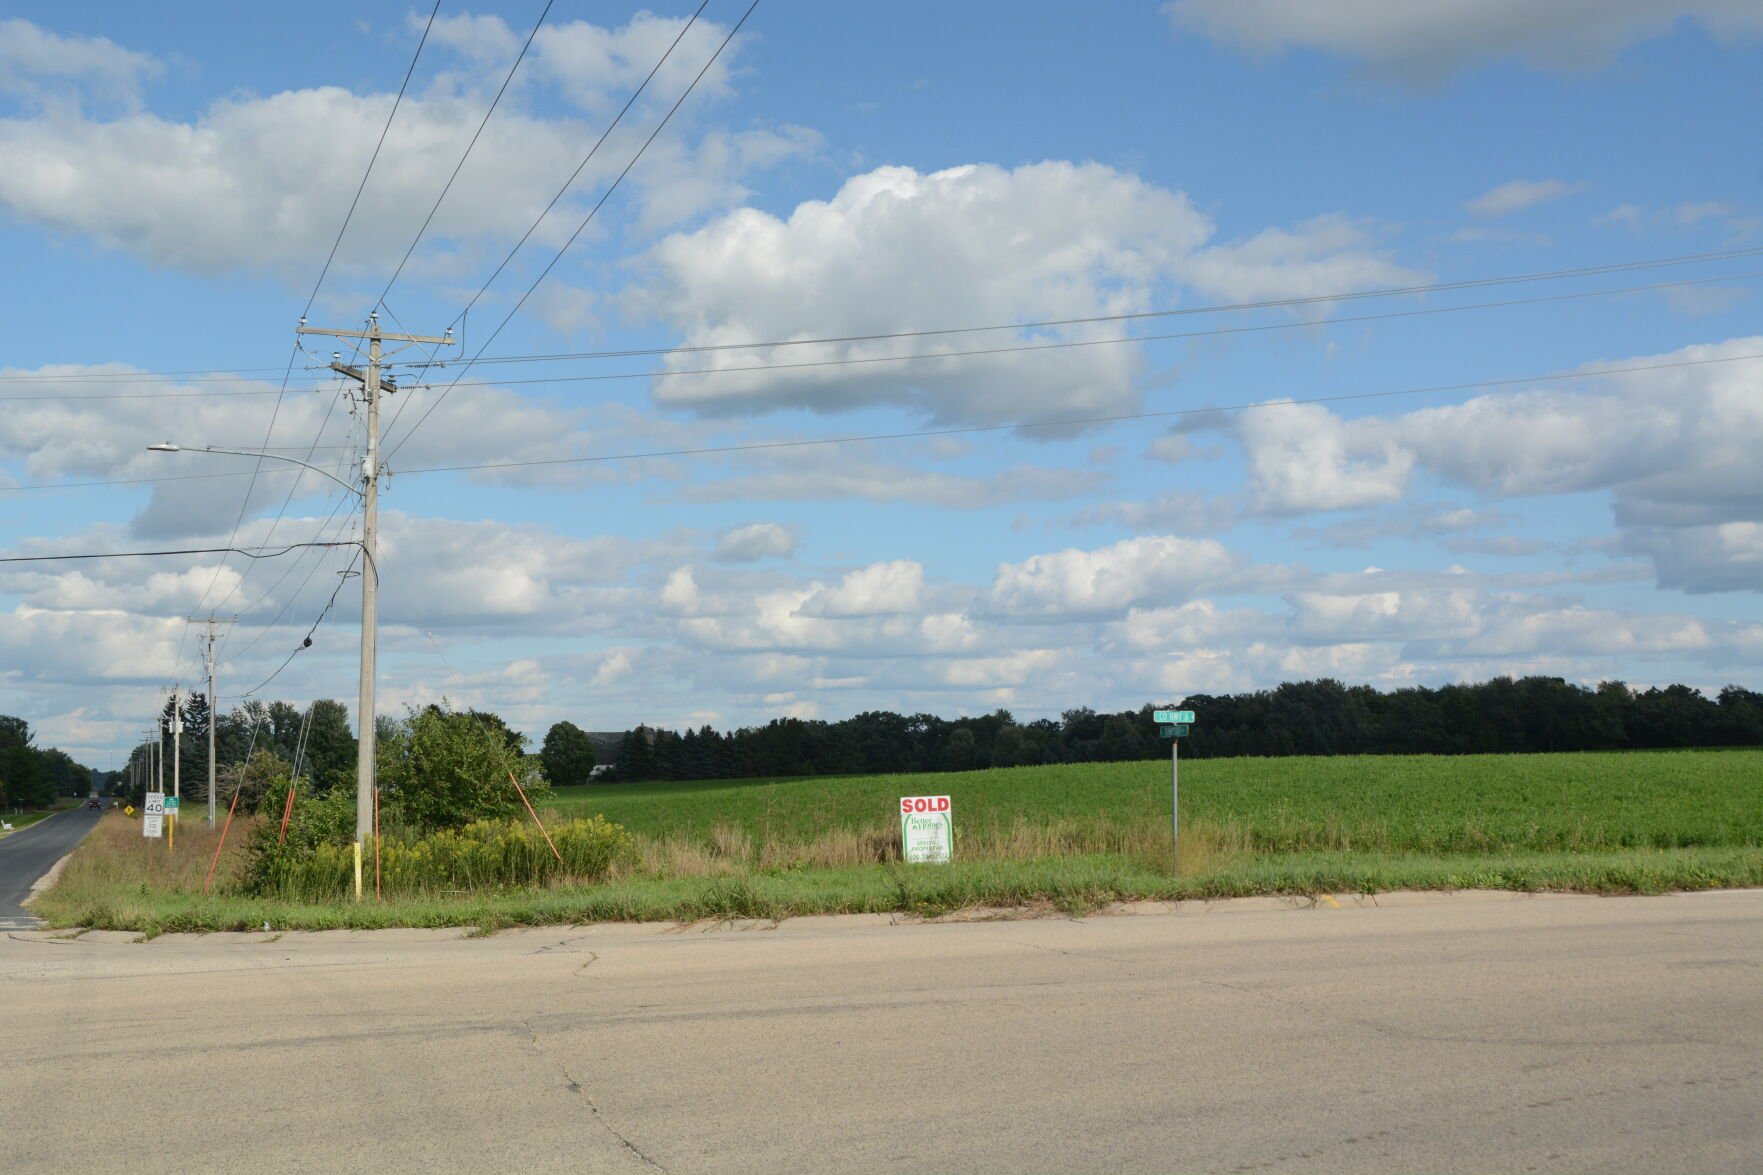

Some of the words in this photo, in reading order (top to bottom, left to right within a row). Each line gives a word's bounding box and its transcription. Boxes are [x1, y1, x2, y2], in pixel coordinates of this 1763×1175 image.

[147, 804, 162, 812] 40
[902, 798, 949, 813] SOLD
[911, 817, 932, 825] Better
